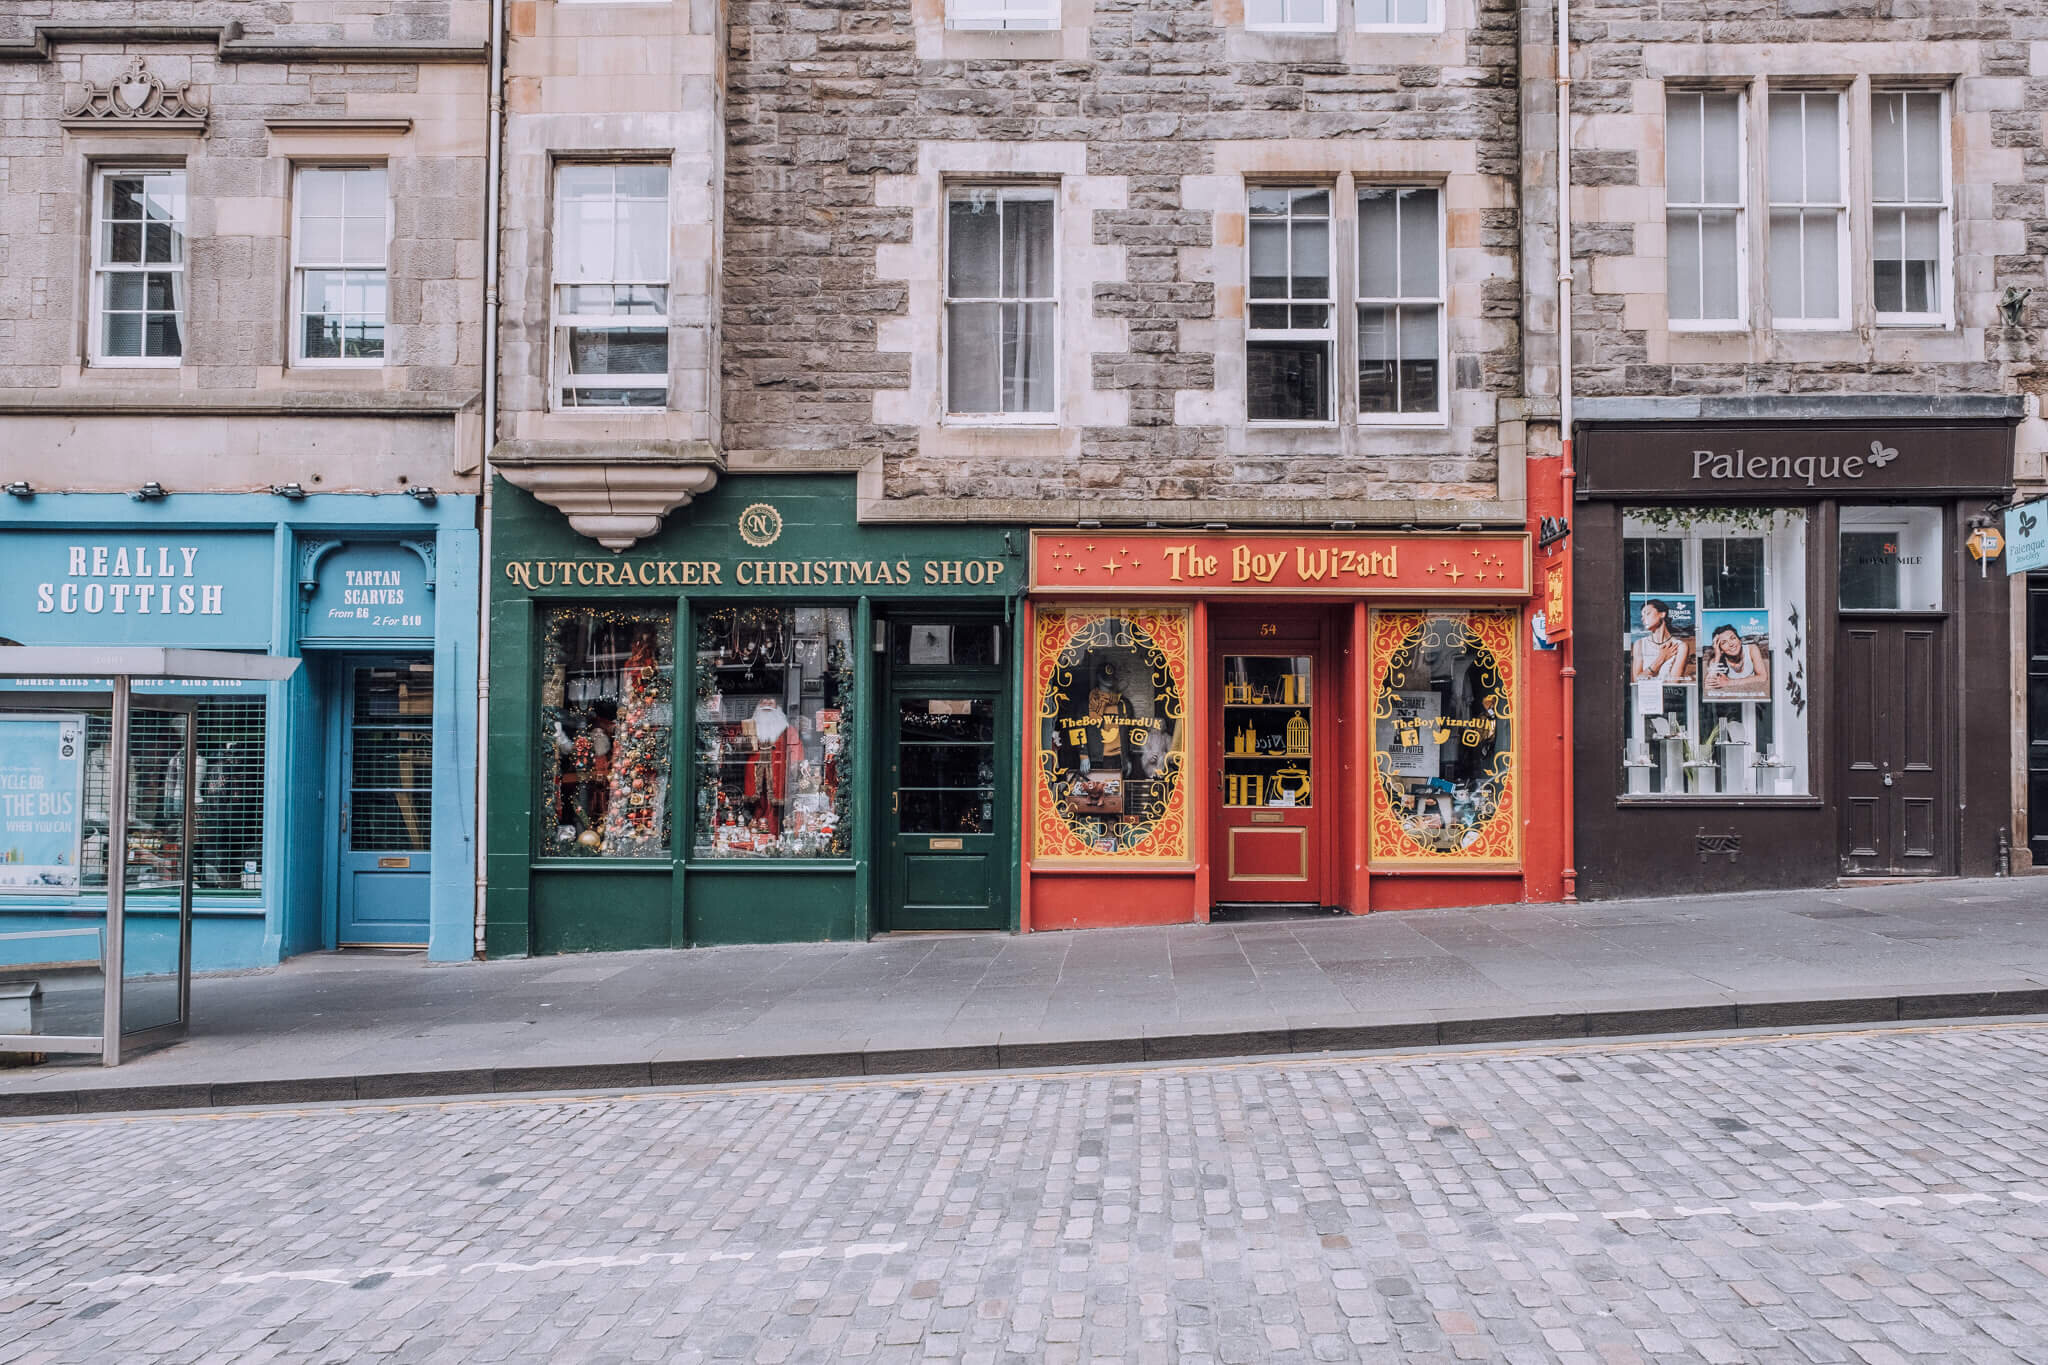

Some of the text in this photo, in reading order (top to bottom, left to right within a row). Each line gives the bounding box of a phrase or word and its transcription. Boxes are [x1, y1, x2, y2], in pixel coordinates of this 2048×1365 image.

[1692, 449, 1864, 486] Palenque
[68, 546, 200, 577] REALLY
[1163, 544, 1399, 583] The Boy Wizard
[345, 570, 401, 586] TARTAN
[505, 560, 1005, 590] NUTCRACKER CHRISTMAS SHOP
[37, 583, 224, 615] SCOTTISH
[344, 589, 405, 605] SCARVES
[328, 608, 354, 619] From
[372, 615, 422, 626] 2 For £10
[1260, 623, 1278, 636] 54
[1060, 715, 1163, 730] TheBoyWizardUK
[2, 791, 73, 817] THE BUS
